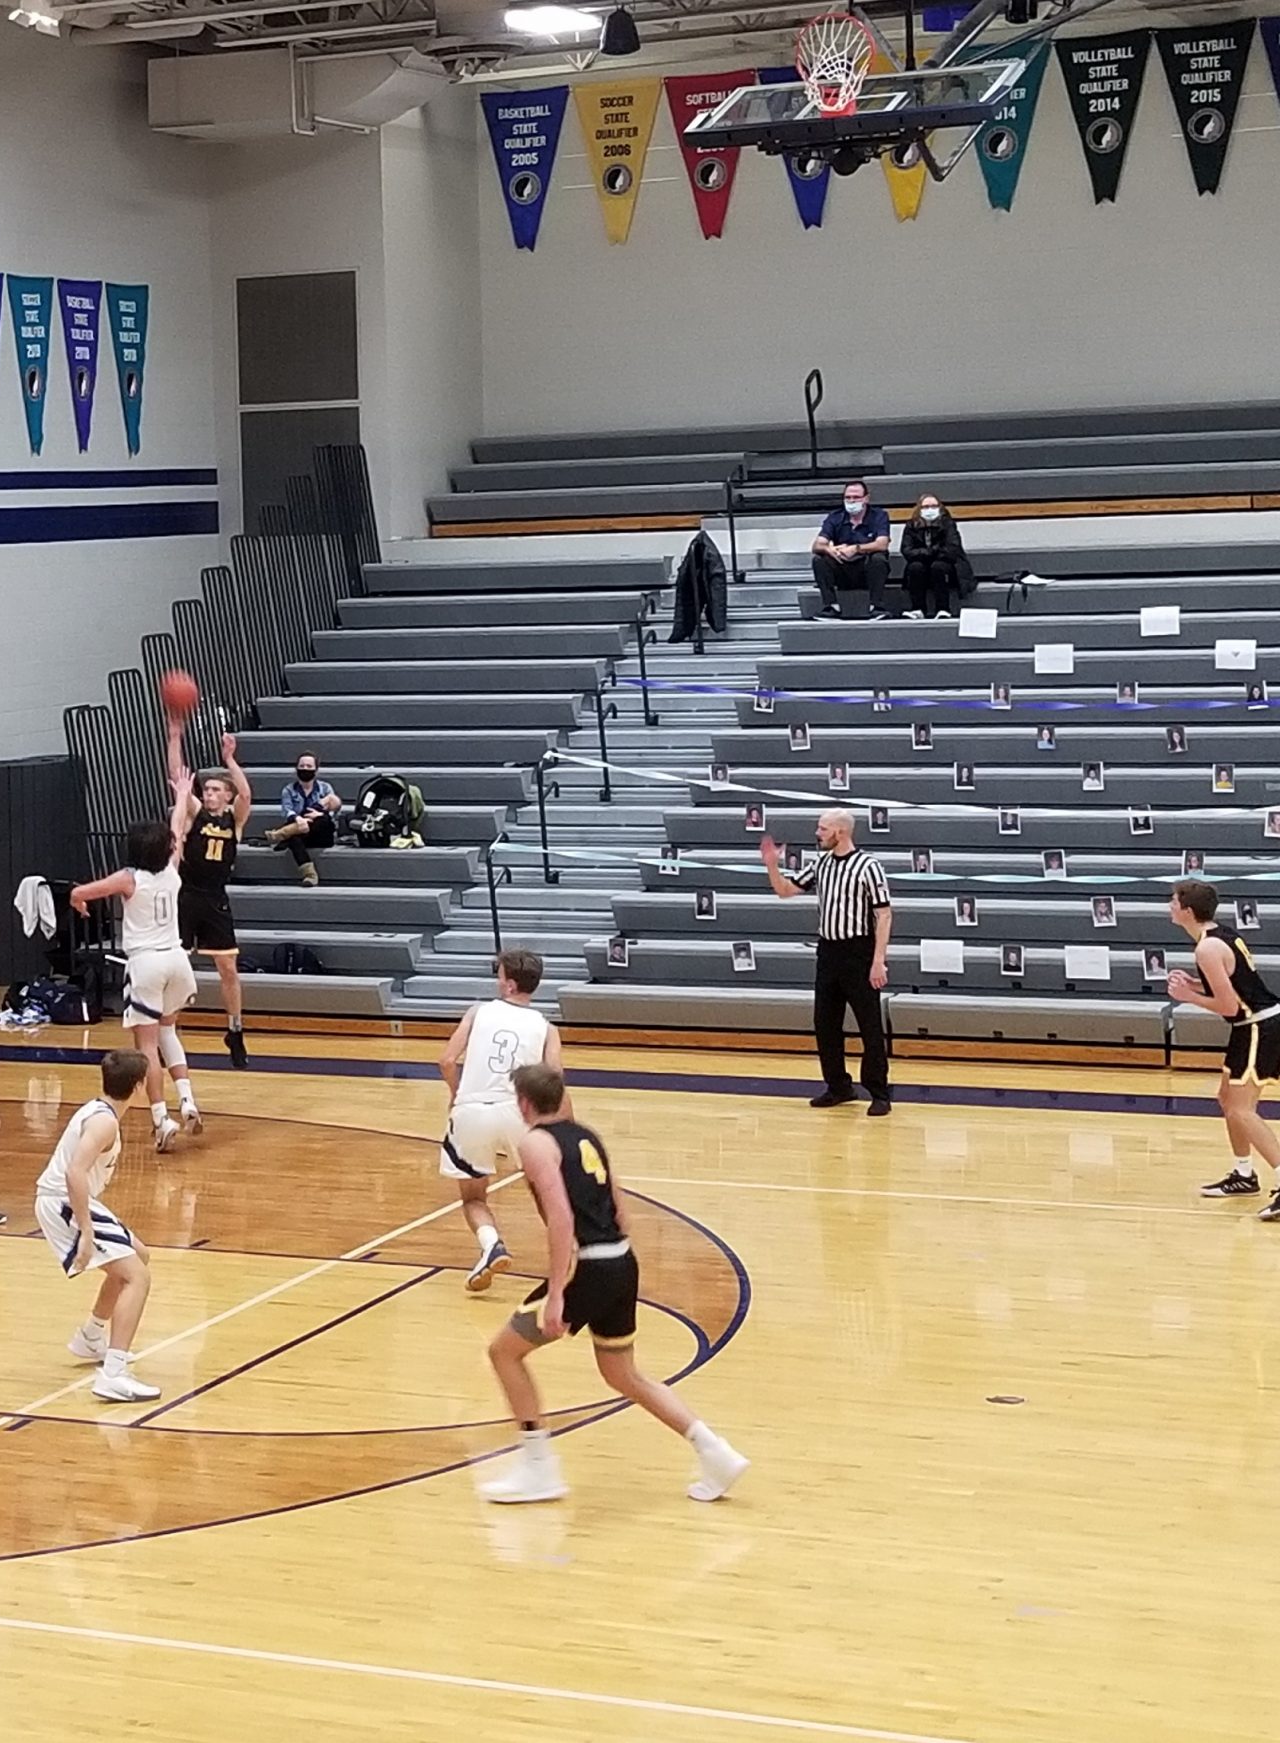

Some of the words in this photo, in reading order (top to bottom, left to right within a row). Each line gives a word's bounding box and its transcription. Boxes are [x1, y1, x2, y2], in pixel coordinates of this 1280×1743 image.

[1173, 37, 1237, 55] VOLLEYBALL
[1072, 46, 1135, 63] VOLLEYBALL
[1190, 55, 1221, 70] STATE
[1088, 64, 1119, 79] STATE
[1180, 70, 1232, 85] QUALIFIER
[1079, 79, 1129, 94] QUALIFIER
[600, 95, 634, 109] SOCCER
[1190, 88, 1221, 104] 2015
[497, 104, 552, 120] BASKETBALL
[1088, 97, 1121, 113] 2014
[604, 111, 630, 125] STATE
[512, 122, 539, 135] STATE
[595, 126, 639, 141] QUALIFIER
[504, 136, 547, 149] QUALIFIER
[603, 144, 632, 158] 2006
[511, 152, 539, 167] 2005
[487, 1028, 520, 1075] 3
[578, 1138, 607, 1185] 4
